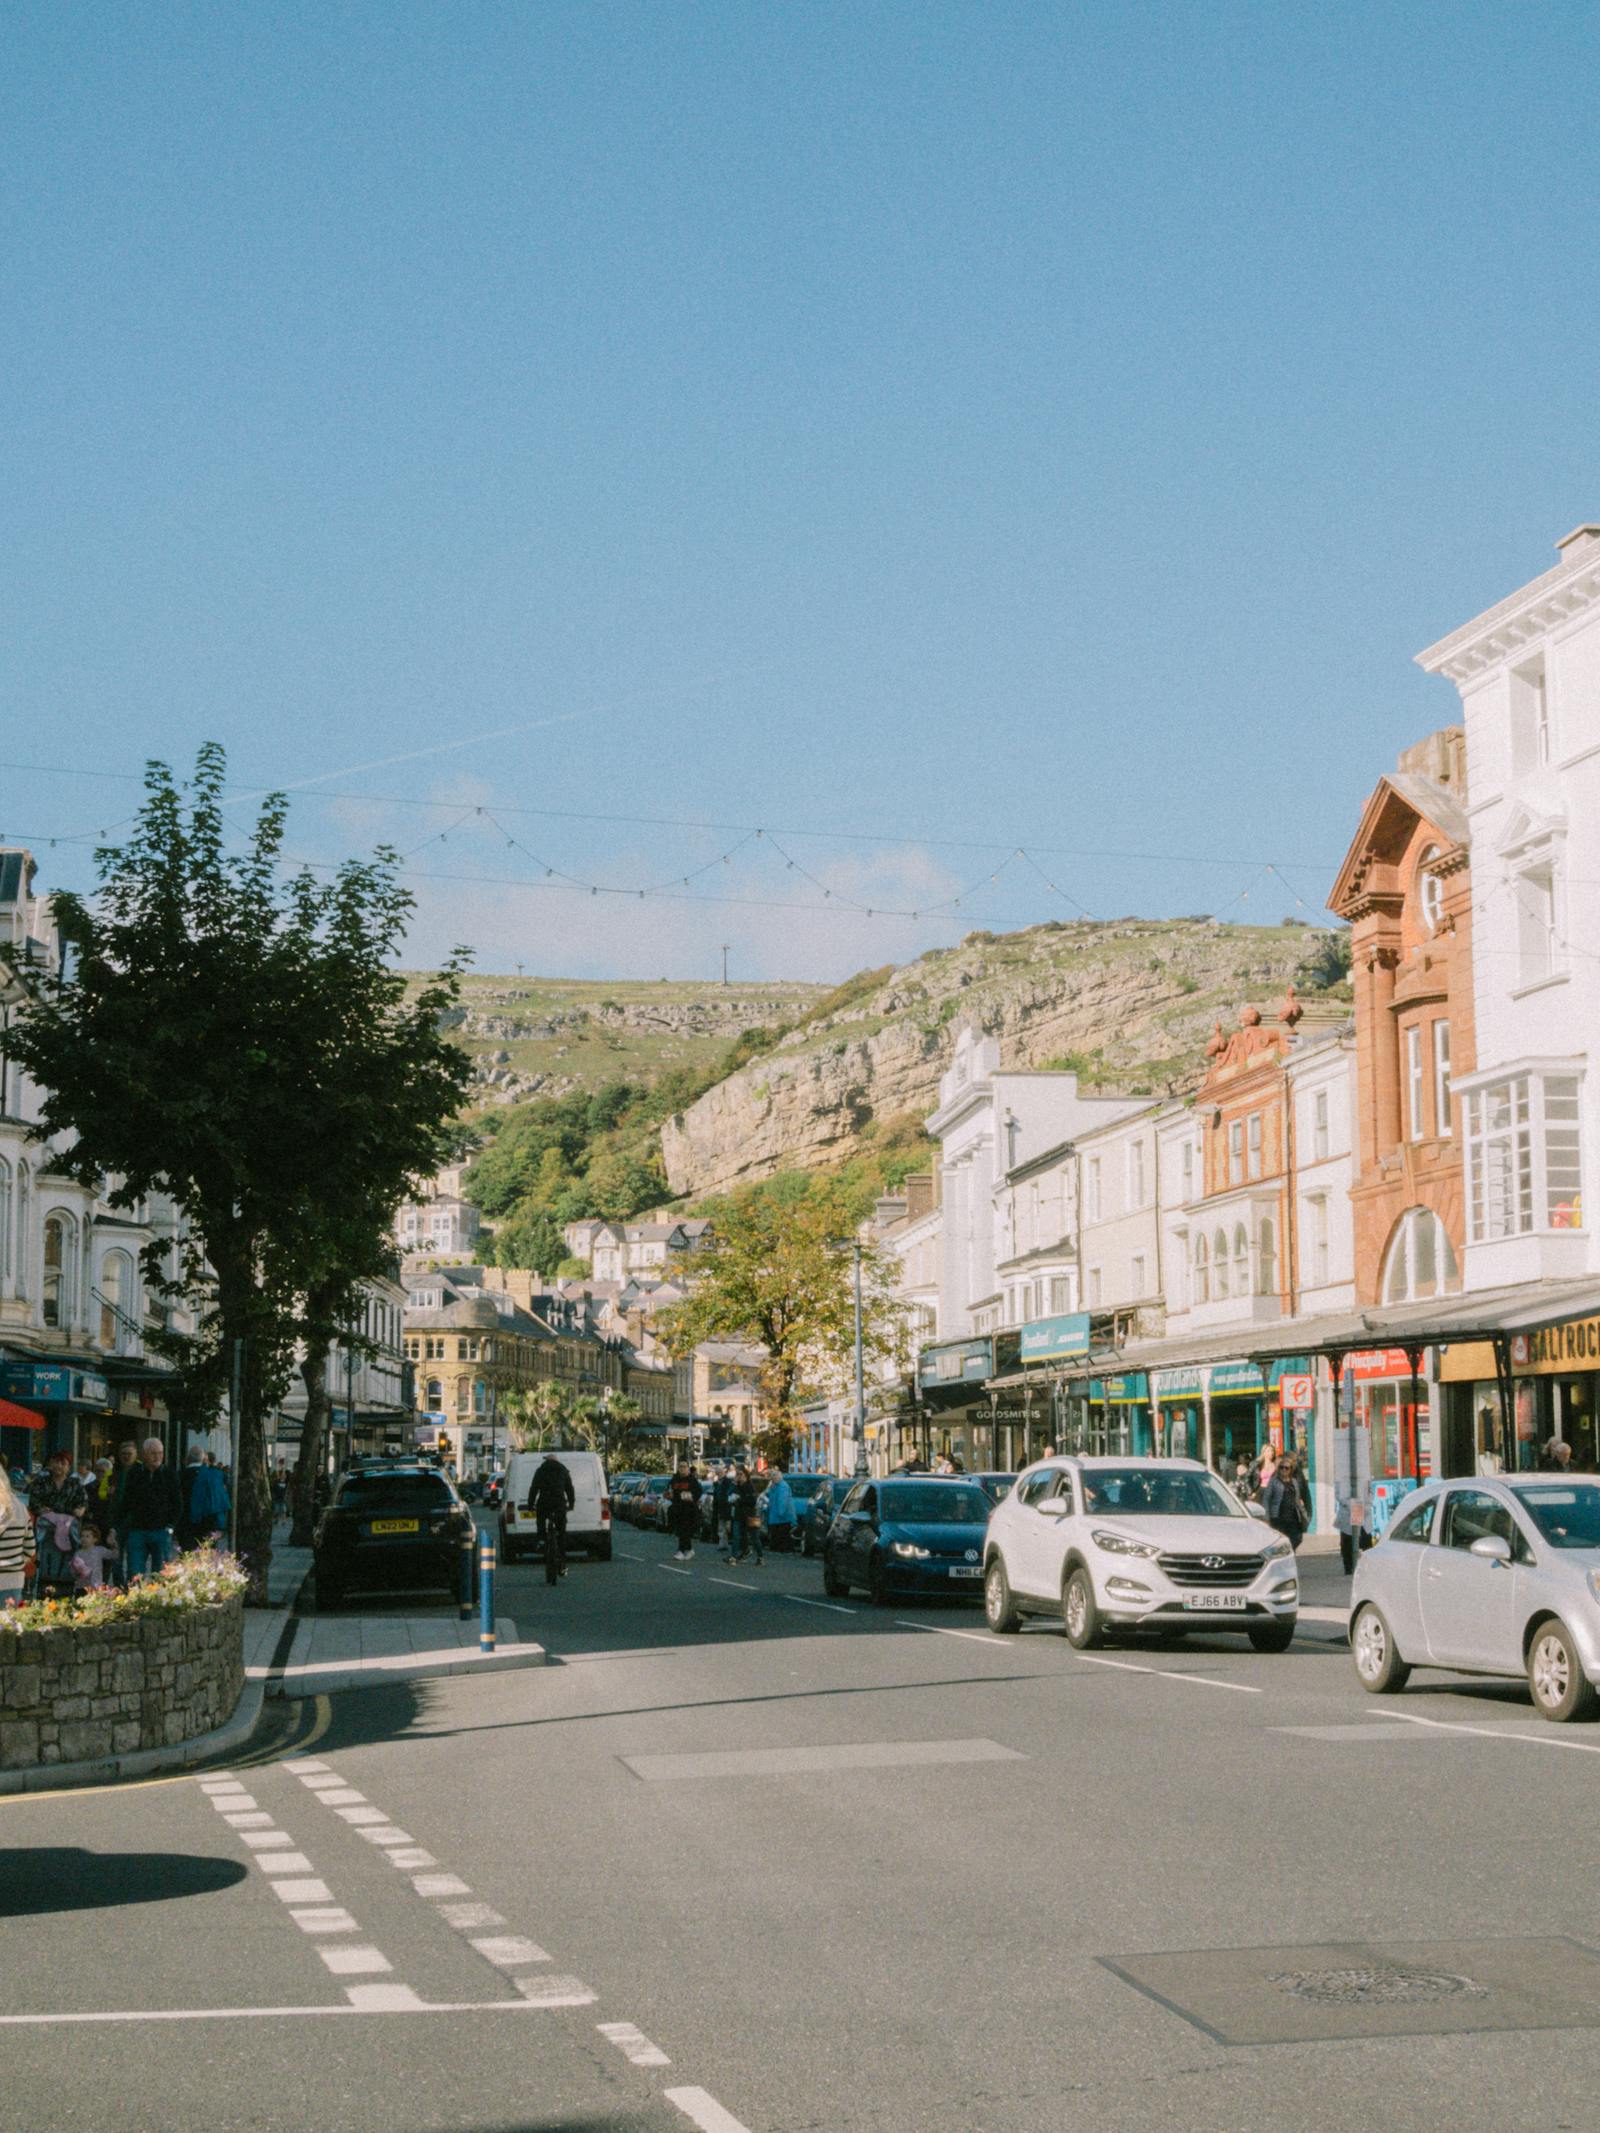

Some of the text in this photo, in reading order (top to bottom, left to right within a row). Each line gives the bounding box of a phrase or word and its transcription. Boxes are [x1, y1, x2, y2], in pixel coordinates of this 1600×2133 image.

[1530, 1321, 1600, 1362] SALTROC
[35, 1372, 61, 1380] WORK
[1192, 1595, 1243, 1606] EJ66 ABV
